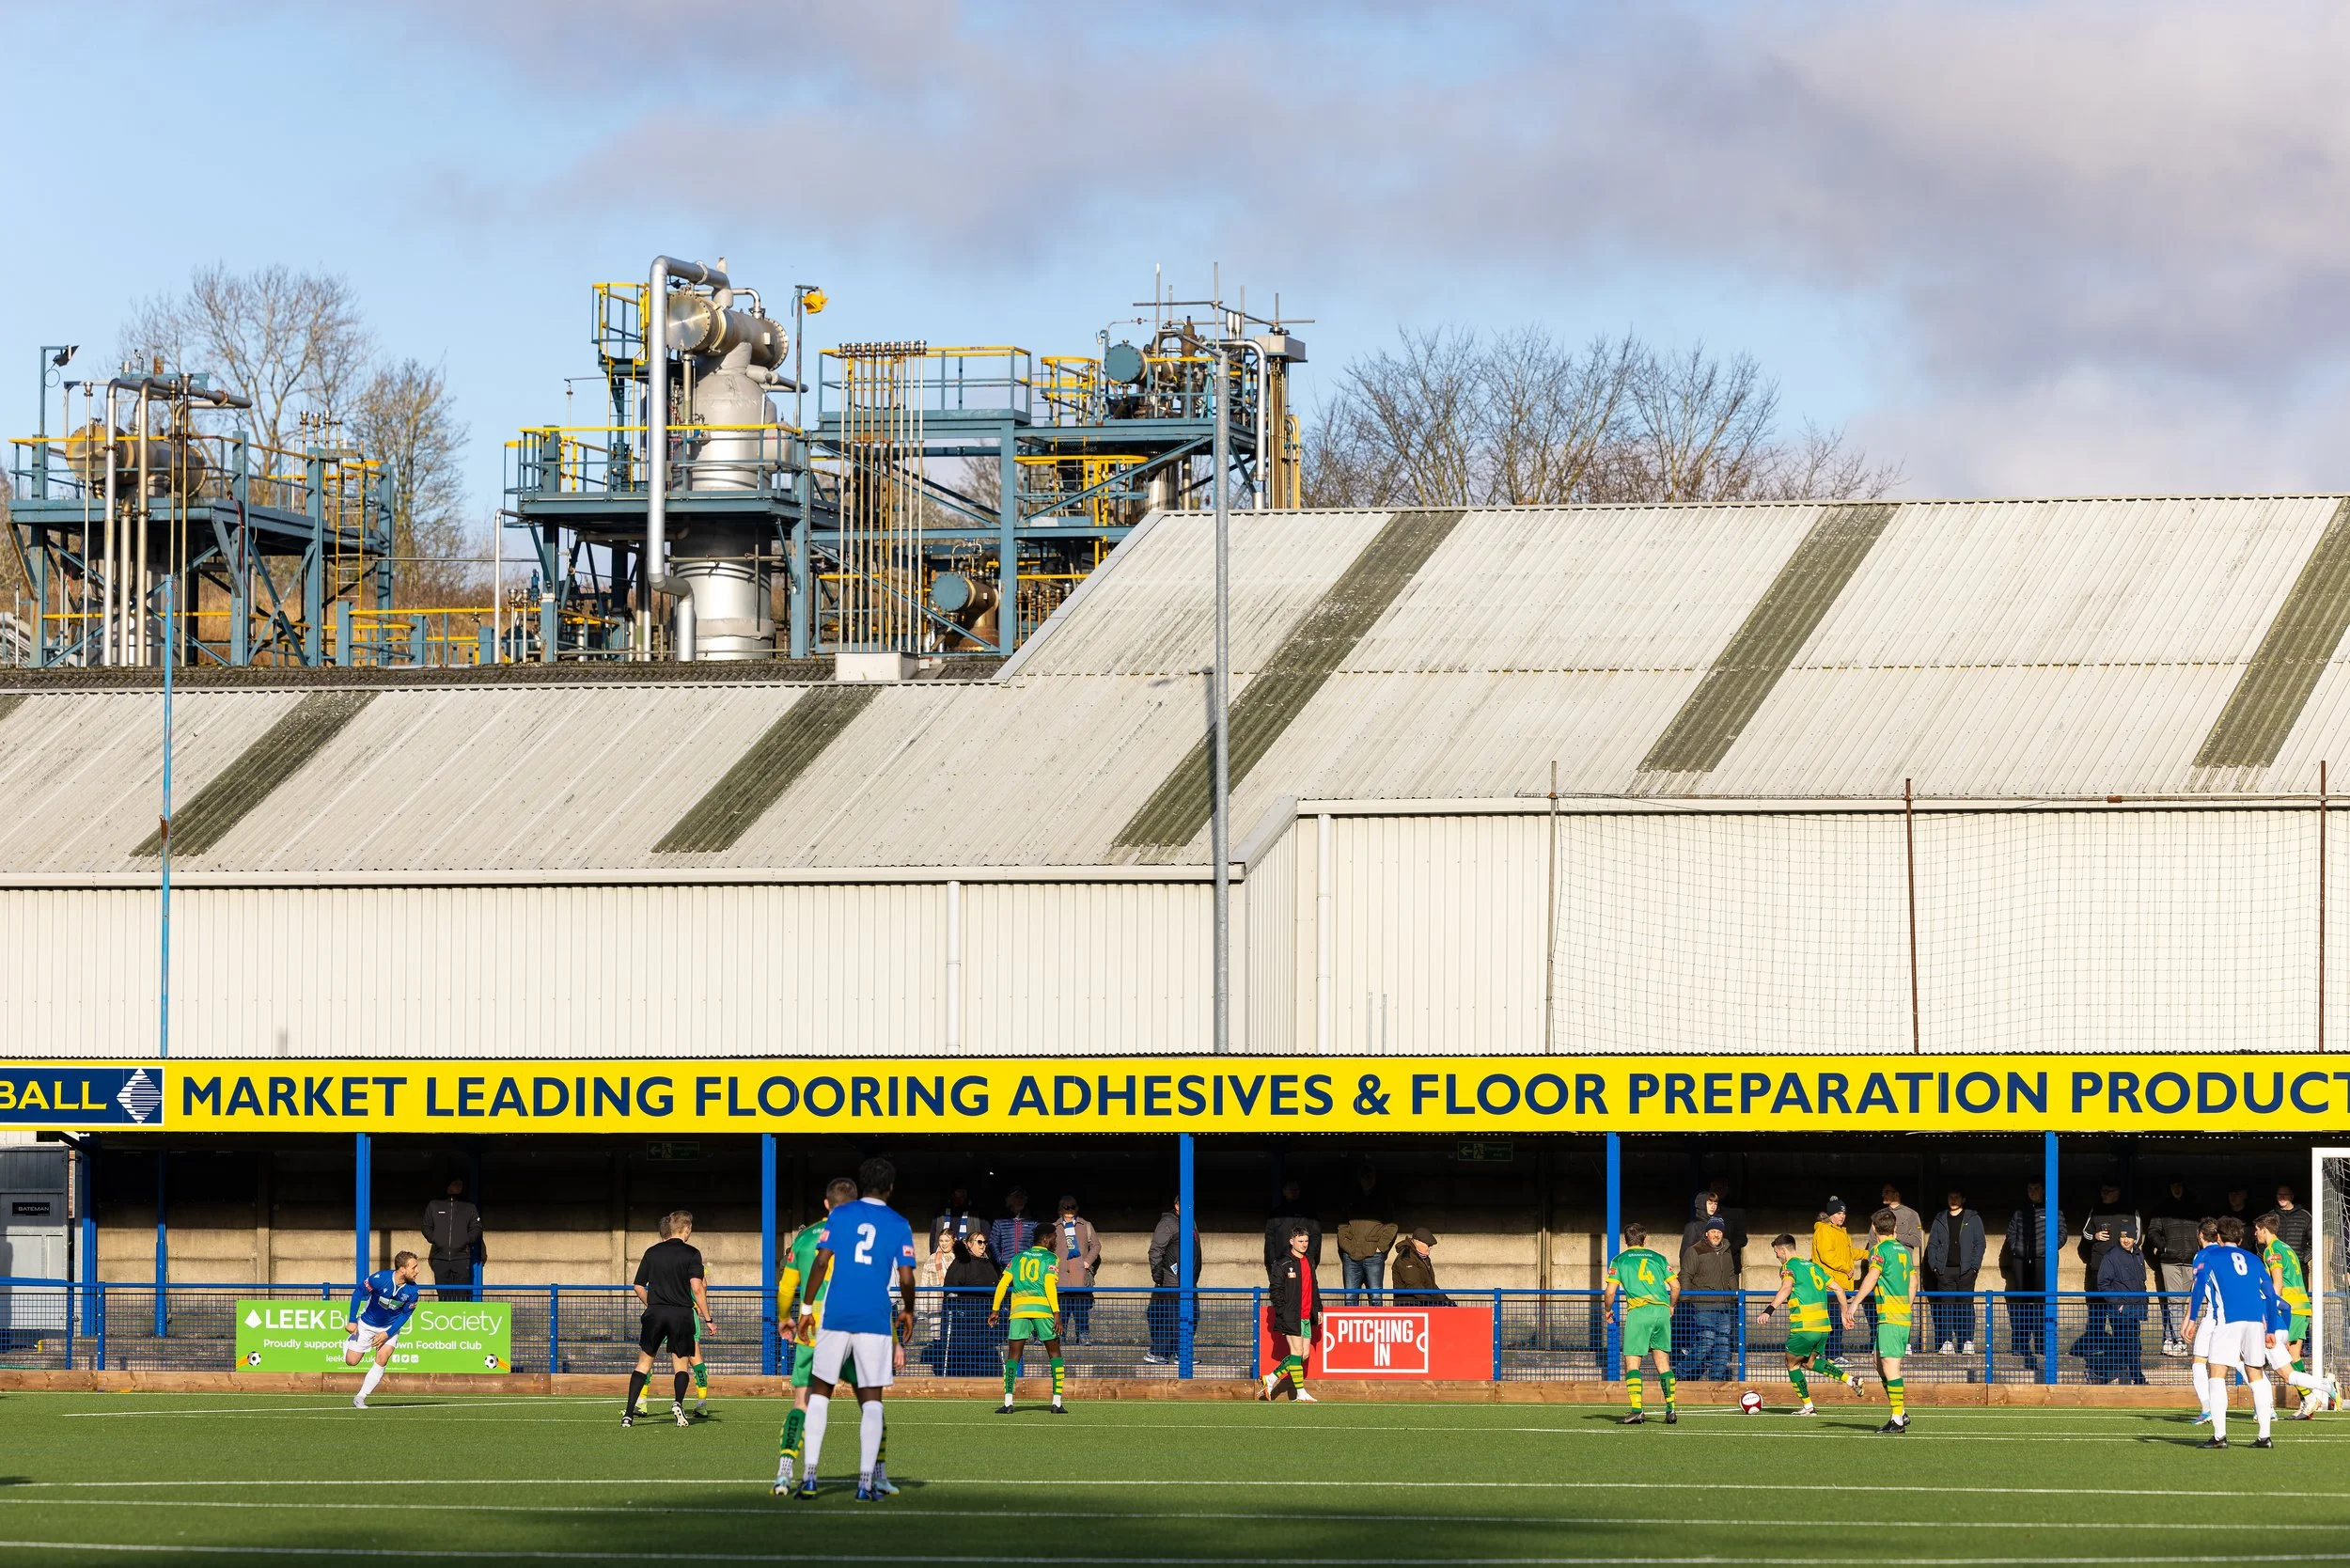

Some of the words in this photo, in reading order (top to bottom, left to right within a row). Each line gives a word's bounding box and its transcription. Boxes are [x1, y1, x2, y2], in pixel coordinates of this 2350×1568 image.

[0, 1080, 107, 1109] BALL
[183, 1076, 407, 1116] MARKET
[427, 1076, 673, 1117] LEADING
[697, 1075, 988, 1117] FLOORING
[1009, 1074, 1333, 1116] ADHESIVES
[1354, 1074, 1391, 1115] &
[1413, 1074, 1608, 1115] FLOOR
[1630, 1072, 2046, 1114] PREPARATION
[854, 1223, 876, 1265] 2
[1020, 1257, 1040, 1282] 10
[1638, 1259, 1654, 1284] 4
[1898, 1252, 1907, 1282] 7
[2231, 1252, 2248, 1276] 8
[1810, 1266, 1824, 1291] 6
[265, 1309, 326, 1329] LEEK
[420, 1309, 503, 1335] Society
[1338, 1319, 1414, 1343] PITCHING
[263, 1339, 302, 1350] Proudly
[395, 1341, 414, 1350] own
[415, 1341, 457, 1350] Football
[459, 1341, 482, 1350] Club
[1373, 1342, 1390, 1367] IN
